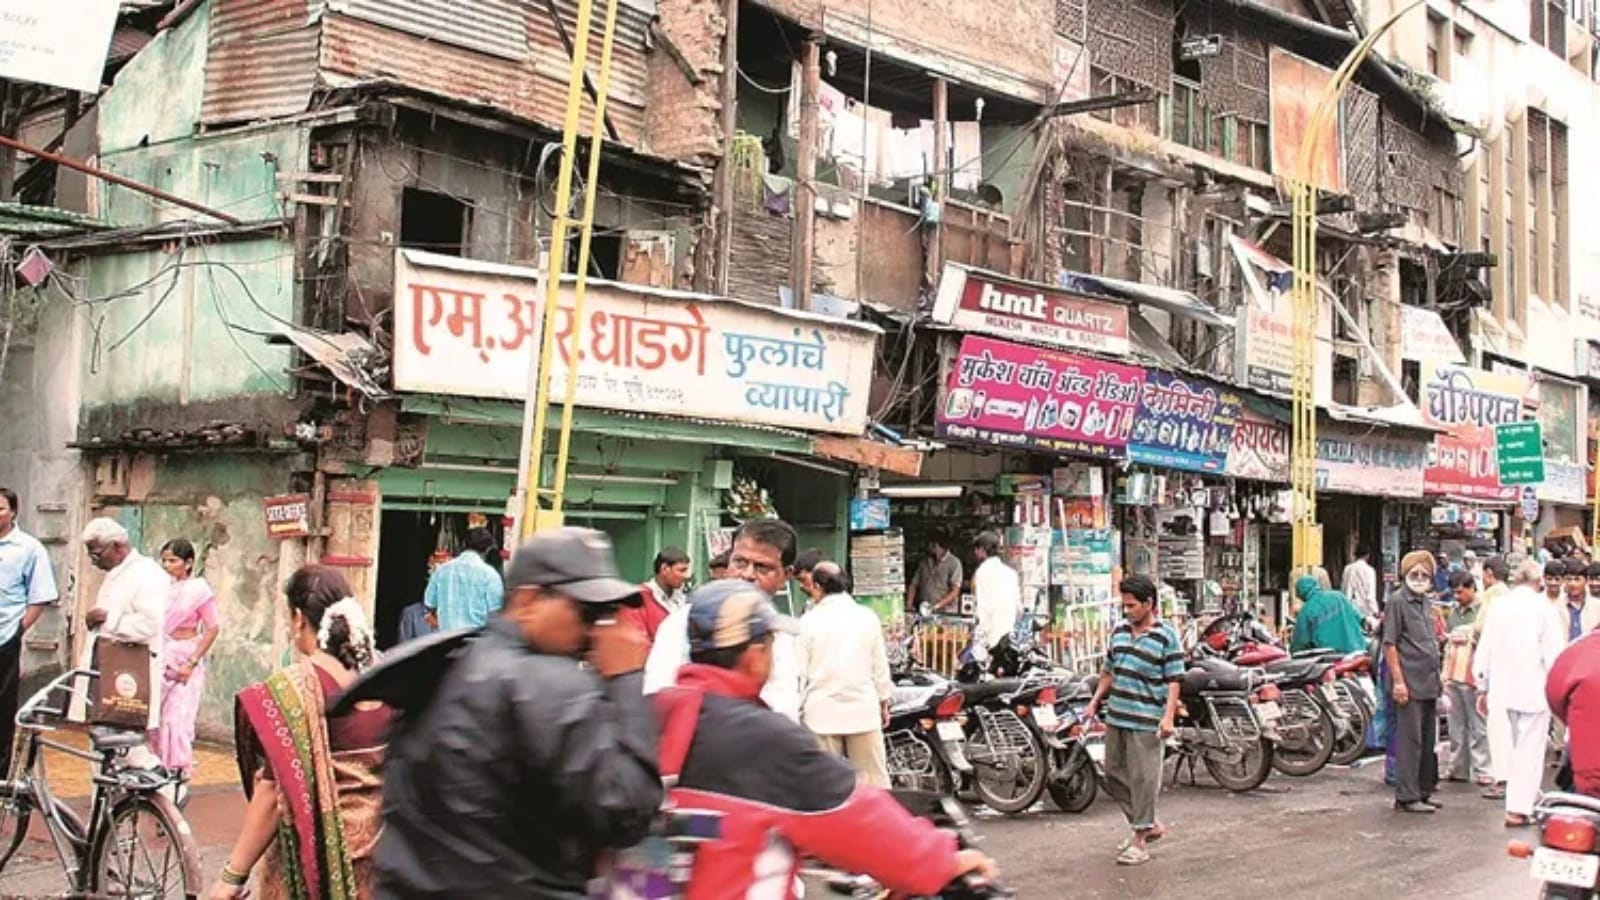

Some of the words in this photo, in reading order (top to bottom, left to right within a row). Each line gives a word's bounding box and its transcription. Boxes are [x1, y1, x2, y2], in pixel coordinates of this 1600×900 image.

[979, 283, 1048, 321] hmt
[1054, 307, 1113, 332] QUARTZ
[985, 314, 1023, 331] MUKESH
[722, 327, 826, 378] फुलांचे
[960, 350, 1014, 385] मुकेश
[745, 381, 851, 422] व्यापारी
